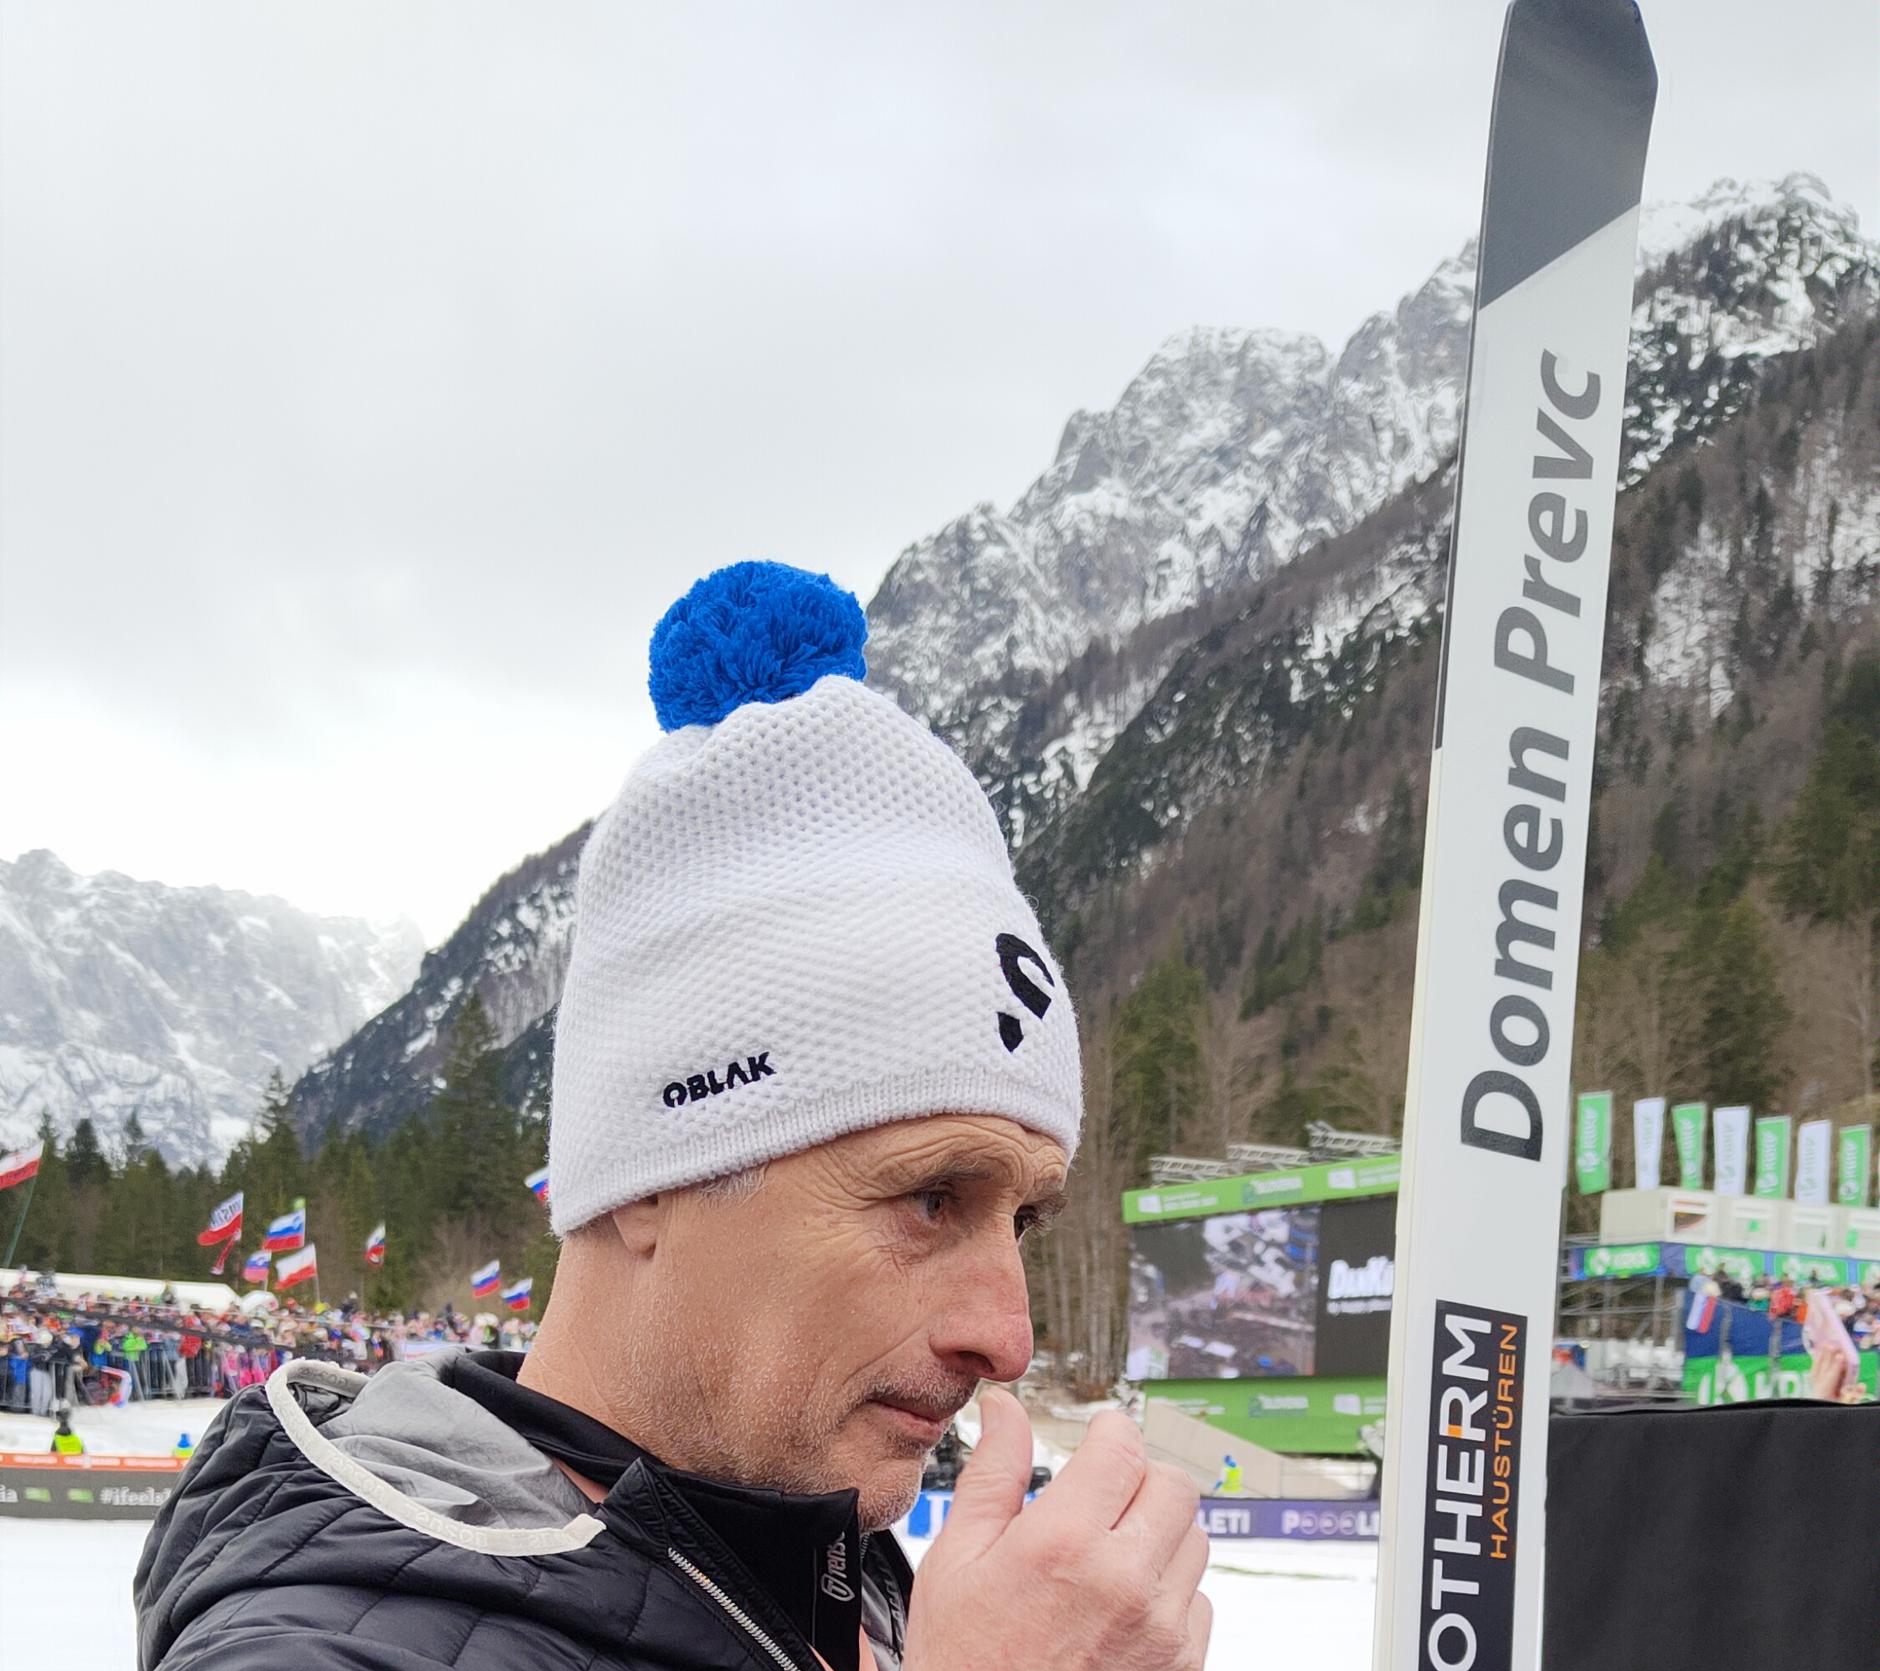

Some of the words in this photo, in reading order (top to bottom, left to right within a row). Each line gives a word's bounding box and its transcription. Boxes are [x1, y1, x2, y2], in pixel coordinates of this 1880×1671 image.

[1493, 347, 1602, 696] Prevc
[663, 1052, 776, 1108] OBLAK
[1460, 722, 1570, 1162] Domen
[1490, 1323, 1519, 1560] HAUSTÜREN
